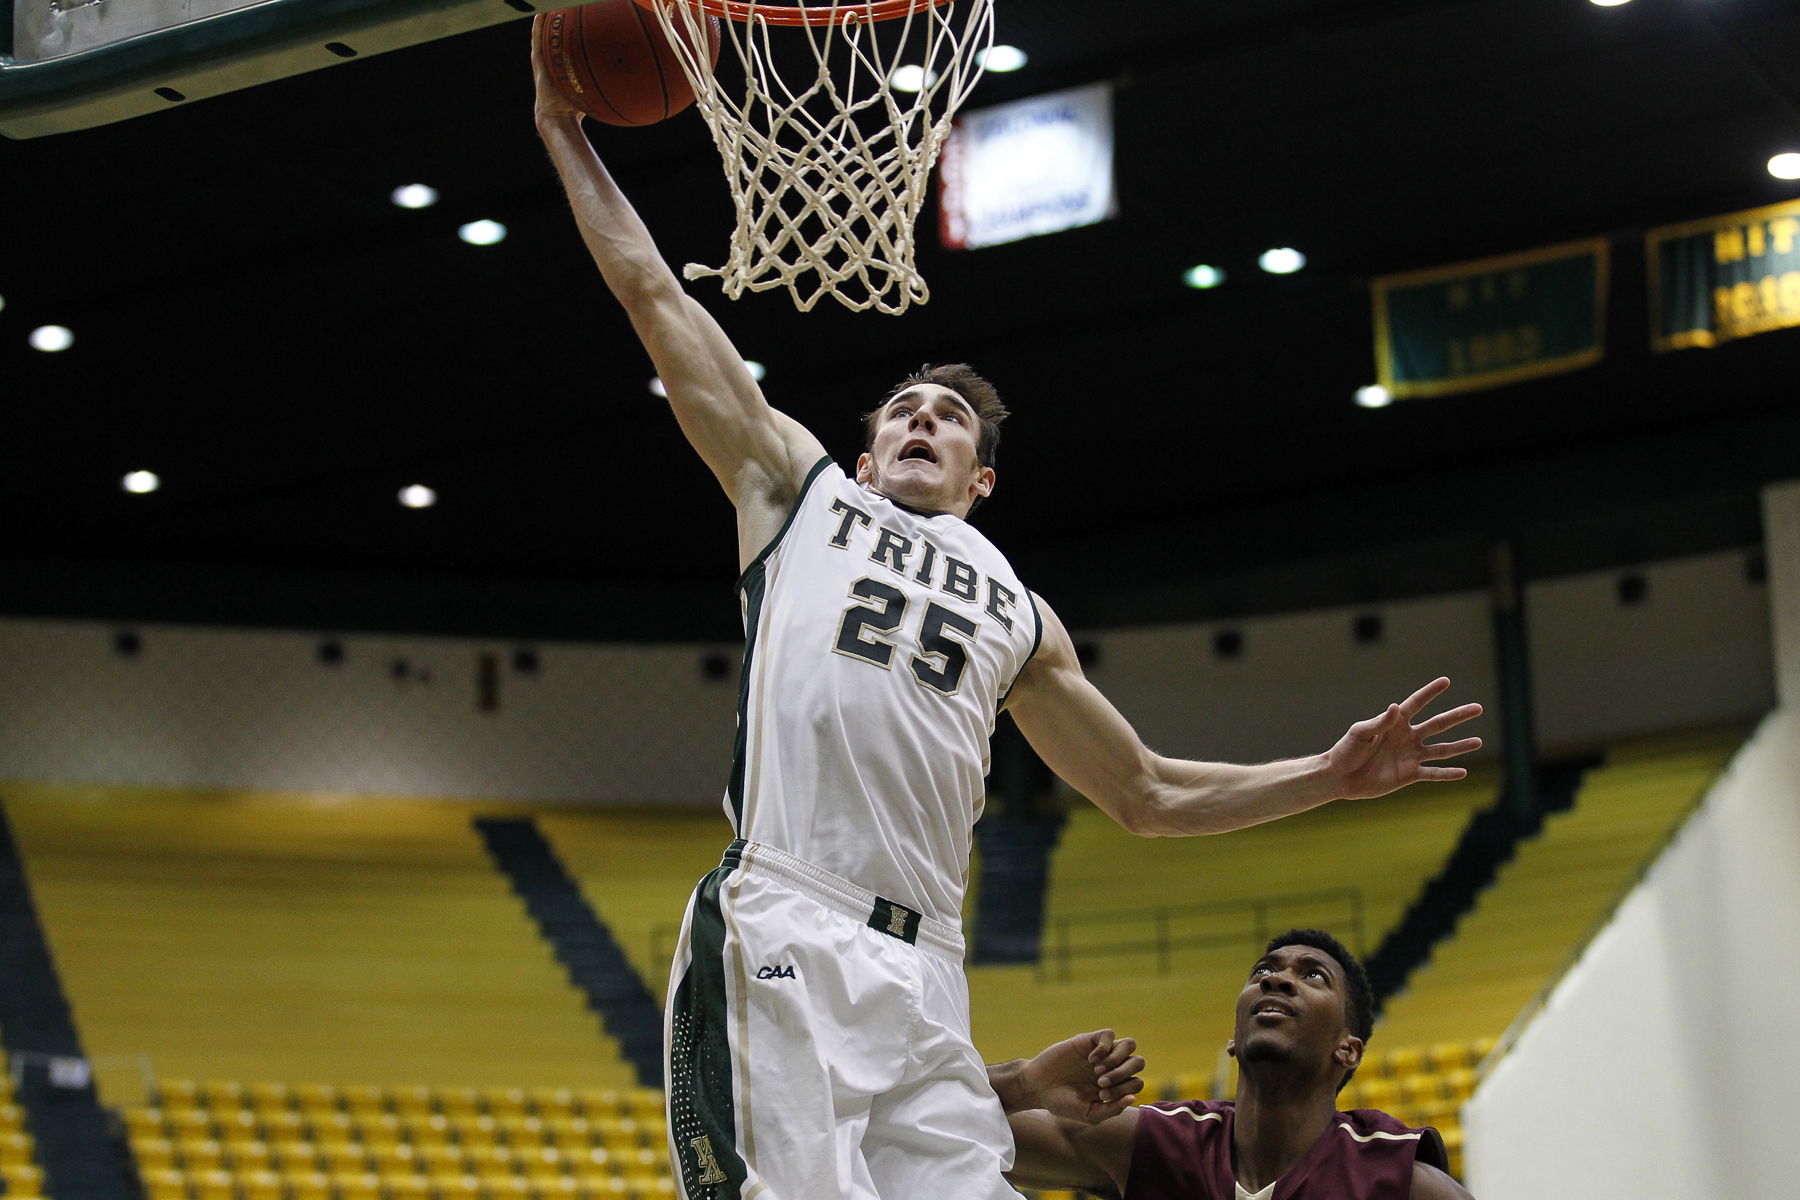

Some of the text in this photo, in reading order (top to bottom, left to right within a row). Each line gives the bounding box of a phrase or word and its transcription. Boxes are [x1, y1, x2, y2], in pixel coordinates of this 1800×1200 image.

[828, 496, 1018, 636] TRIBE
[831, 575, 981, 697] 25
[756, 965, 796, 980] CAA
